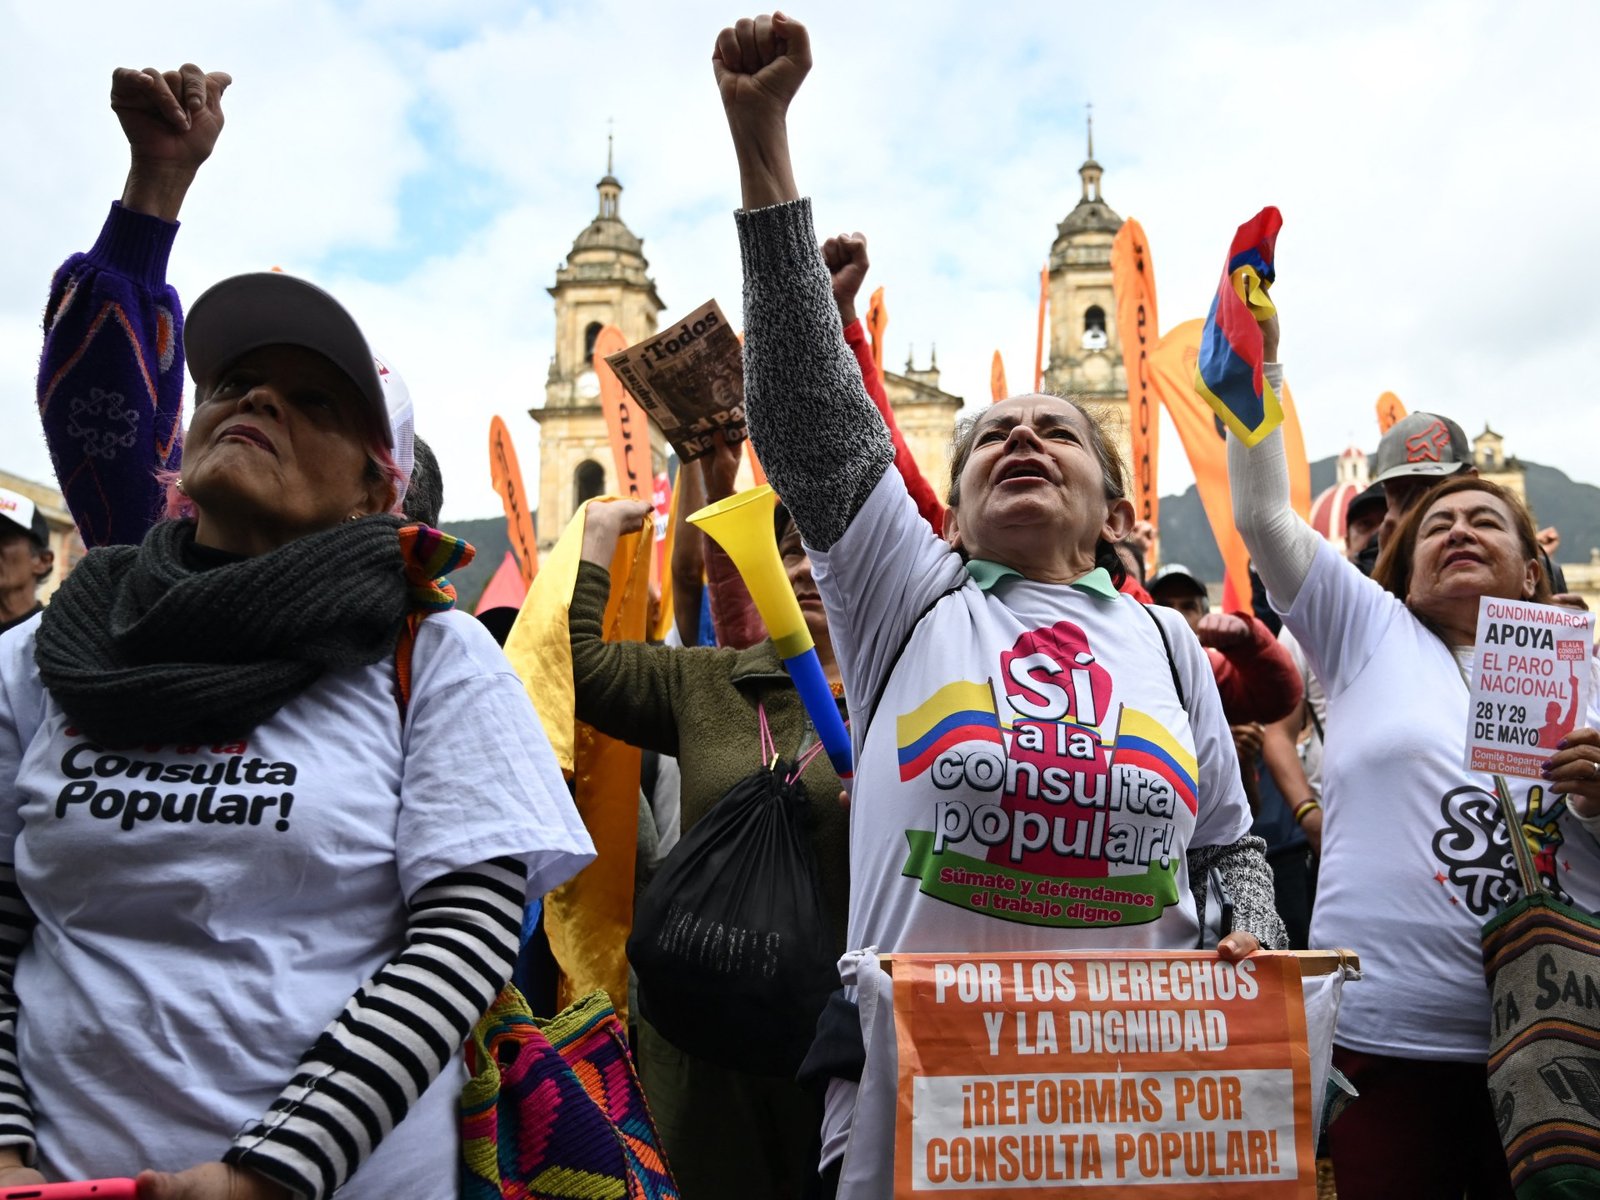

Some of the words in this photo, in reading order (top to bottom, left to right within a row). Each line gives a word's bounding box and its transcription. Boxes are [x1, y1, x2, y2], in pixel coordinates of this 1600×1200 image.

[1487, 603, 1589, 630] CUNDINAMARCA
[1485, 623, 1554, 650] APOYA
[1483, 652, 1502, 671] EL
[1507, 655, 1554, 676] PARO
[1480, 674, 1568, 700] NACIONAL
[1476, 701, 1493, 719] 28
[1497, 704, 1507, 722] Y
[1509, 705, 1526, 724] 29
[1017, 722, 1044, 753] a
[1055, 722, 1095, 760] la
[1475, 722, 1494, 741] DE
[1498, 724, 1539, 747] MAYO
[60, 742, 297, 786] Consulta
[1472, 760, 1486, 769] por
[1488, 761, 1497, 771] la
[1498, 763, 1536, 775] Consulta
[1474, 749, 1505, 762] Comité
[931, 750, 1176, 819] consulta
[55, 781, 294, 833] Popular!
[932, 801, 1176, 869] popular!
[939, 867, 1016, 891] Súmate
[1020, 881, 1033, 896] y
[1036, 879, 1155, 907] defendamos
[970, 892, 988, 907] el
[992, 893, 1062, 918] trabajo
[1066, 902, 1121, 923] digno
[935, 962, 1002, 1004] POR
[1013, 962, 1078, 1002] LOS
[1088, 959, 1260, 1002] DERECHOS
[982, 1014, 1005, 1056] Y
[1016, 1012, 1059, 1055] LA
[1070, 1010, 1229, 1055] DIGNIDAD
[962, 1078, 1163, 1129] ¡REFORMAS
[1174, 1076, 1243, 1122] POR
[926, 1134, 1104, 1184] CONSULTA
[1115, 1129, 1280, 1181] POPULAR!
